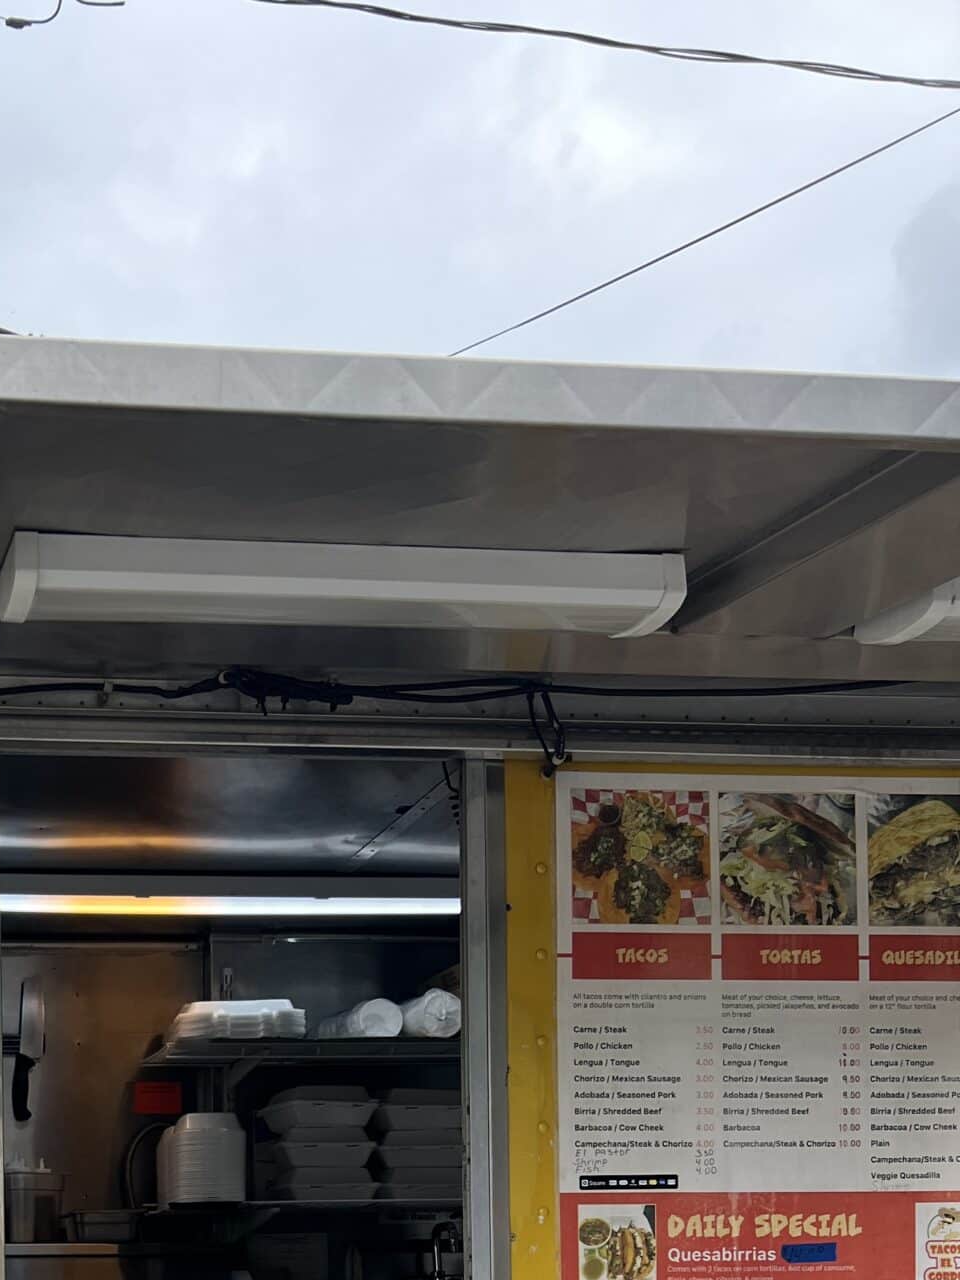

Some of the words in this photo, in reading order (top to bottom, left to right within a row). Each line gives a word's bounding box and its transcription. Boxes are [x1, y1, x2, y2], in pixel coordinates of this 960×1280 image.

[616, 948, 669, 964] TACOS
[760, 949, 822, 965] TORTAS
[573, 1026, 597, 1034] Carne
[604, 1026, 627, 1034] Steak
[722, 1026, 746, 1034] Carne
[752, 1026, 775, 1034] Steak
[870, 1026, 893, 1034] Carne
[900, 1026, 922, 1034] Steak
[574, 1042, 594, 1050] Pollo
[600, 1042, 633, 1050] Chicken
[722, 1042, 742, 1050] Pollo
[748, 1042, 781, 1050] Chicken
[574, 1058, 603, 1067] Lengua
[610, 1058, 640, 1067] Tongue
[722, 1059, 752, 1068] Lengua
[759, 1059, 788, 1068] Tongue
[870, 1059, 898, 1068] Lengua
[906, 1059, 934, 1068] Tongue
[574, 1075, 604, 1083] Chorizo
[612, 1075, 646, 1083] Mexican
[647, 1075, 681, 1084] Sausage
[722, 1075, 754, 1083] Chorizo
[760, 1075, 793, 1083] Mexican
[794, 1075, 828, 1084] Sausage
[722, 1108, 744, 1116] Birria
[752, 1108, 790, 1116] Shredded
[791, 1108, 810, 1116] Beef
[574, 1124, 612, 1132] Barbacoa
[618, 1124, 637, 1132] Cow
[638, 1124, 664, 1132] Cheek
[723, 1124, 760, 1132] Barbacoa
[662, 1140, 694, 1148] Chorizo
[806, 1140, 836, 1148] Chorizo
[870, 1140, 890, 1148] Plain
[870, 1172, 898, 1181] Veggie
[667, 1213, 744, 1238] DAILY
[754, 1213, 863, 1238] SPECIAL
[667, 1246, 776, 1262] Quesabirrias
[928, 1272, 960, 1280] GORD
